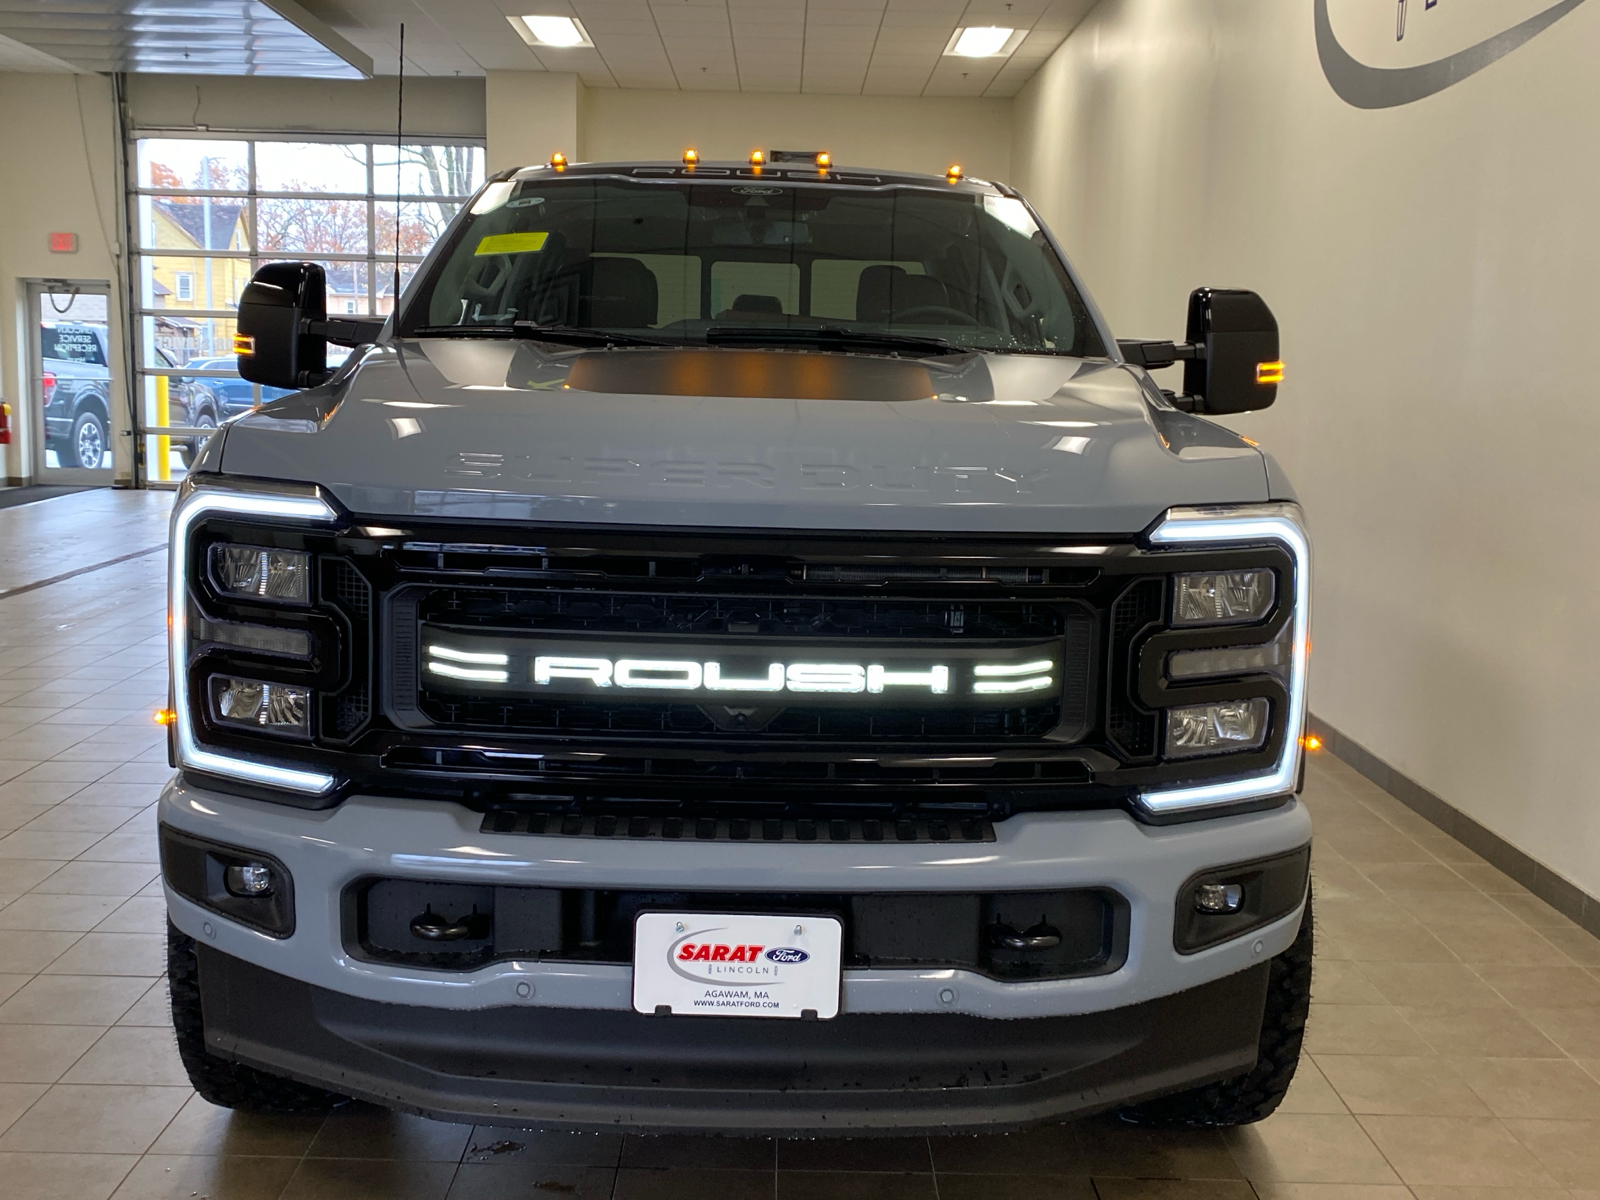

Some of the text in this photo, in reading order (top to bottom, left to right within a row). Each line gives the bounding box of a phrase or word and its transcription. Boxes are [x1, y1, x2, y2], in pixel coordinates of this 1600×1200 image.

[632, 168, 881, 183] ROUSH
[740, 186, 774, 195] Ford
[533, 655, 950, 694] ROUSH
[676, 943, 765, 963] SARAT
[772, 948, 802, 963] Ford
[716, 966, 770, 974] LINCOLN
[704, 989, 770, 999] AGAWAM, MA
[693, 1000, 780, 1008] WWW.SARATFORD.COM
